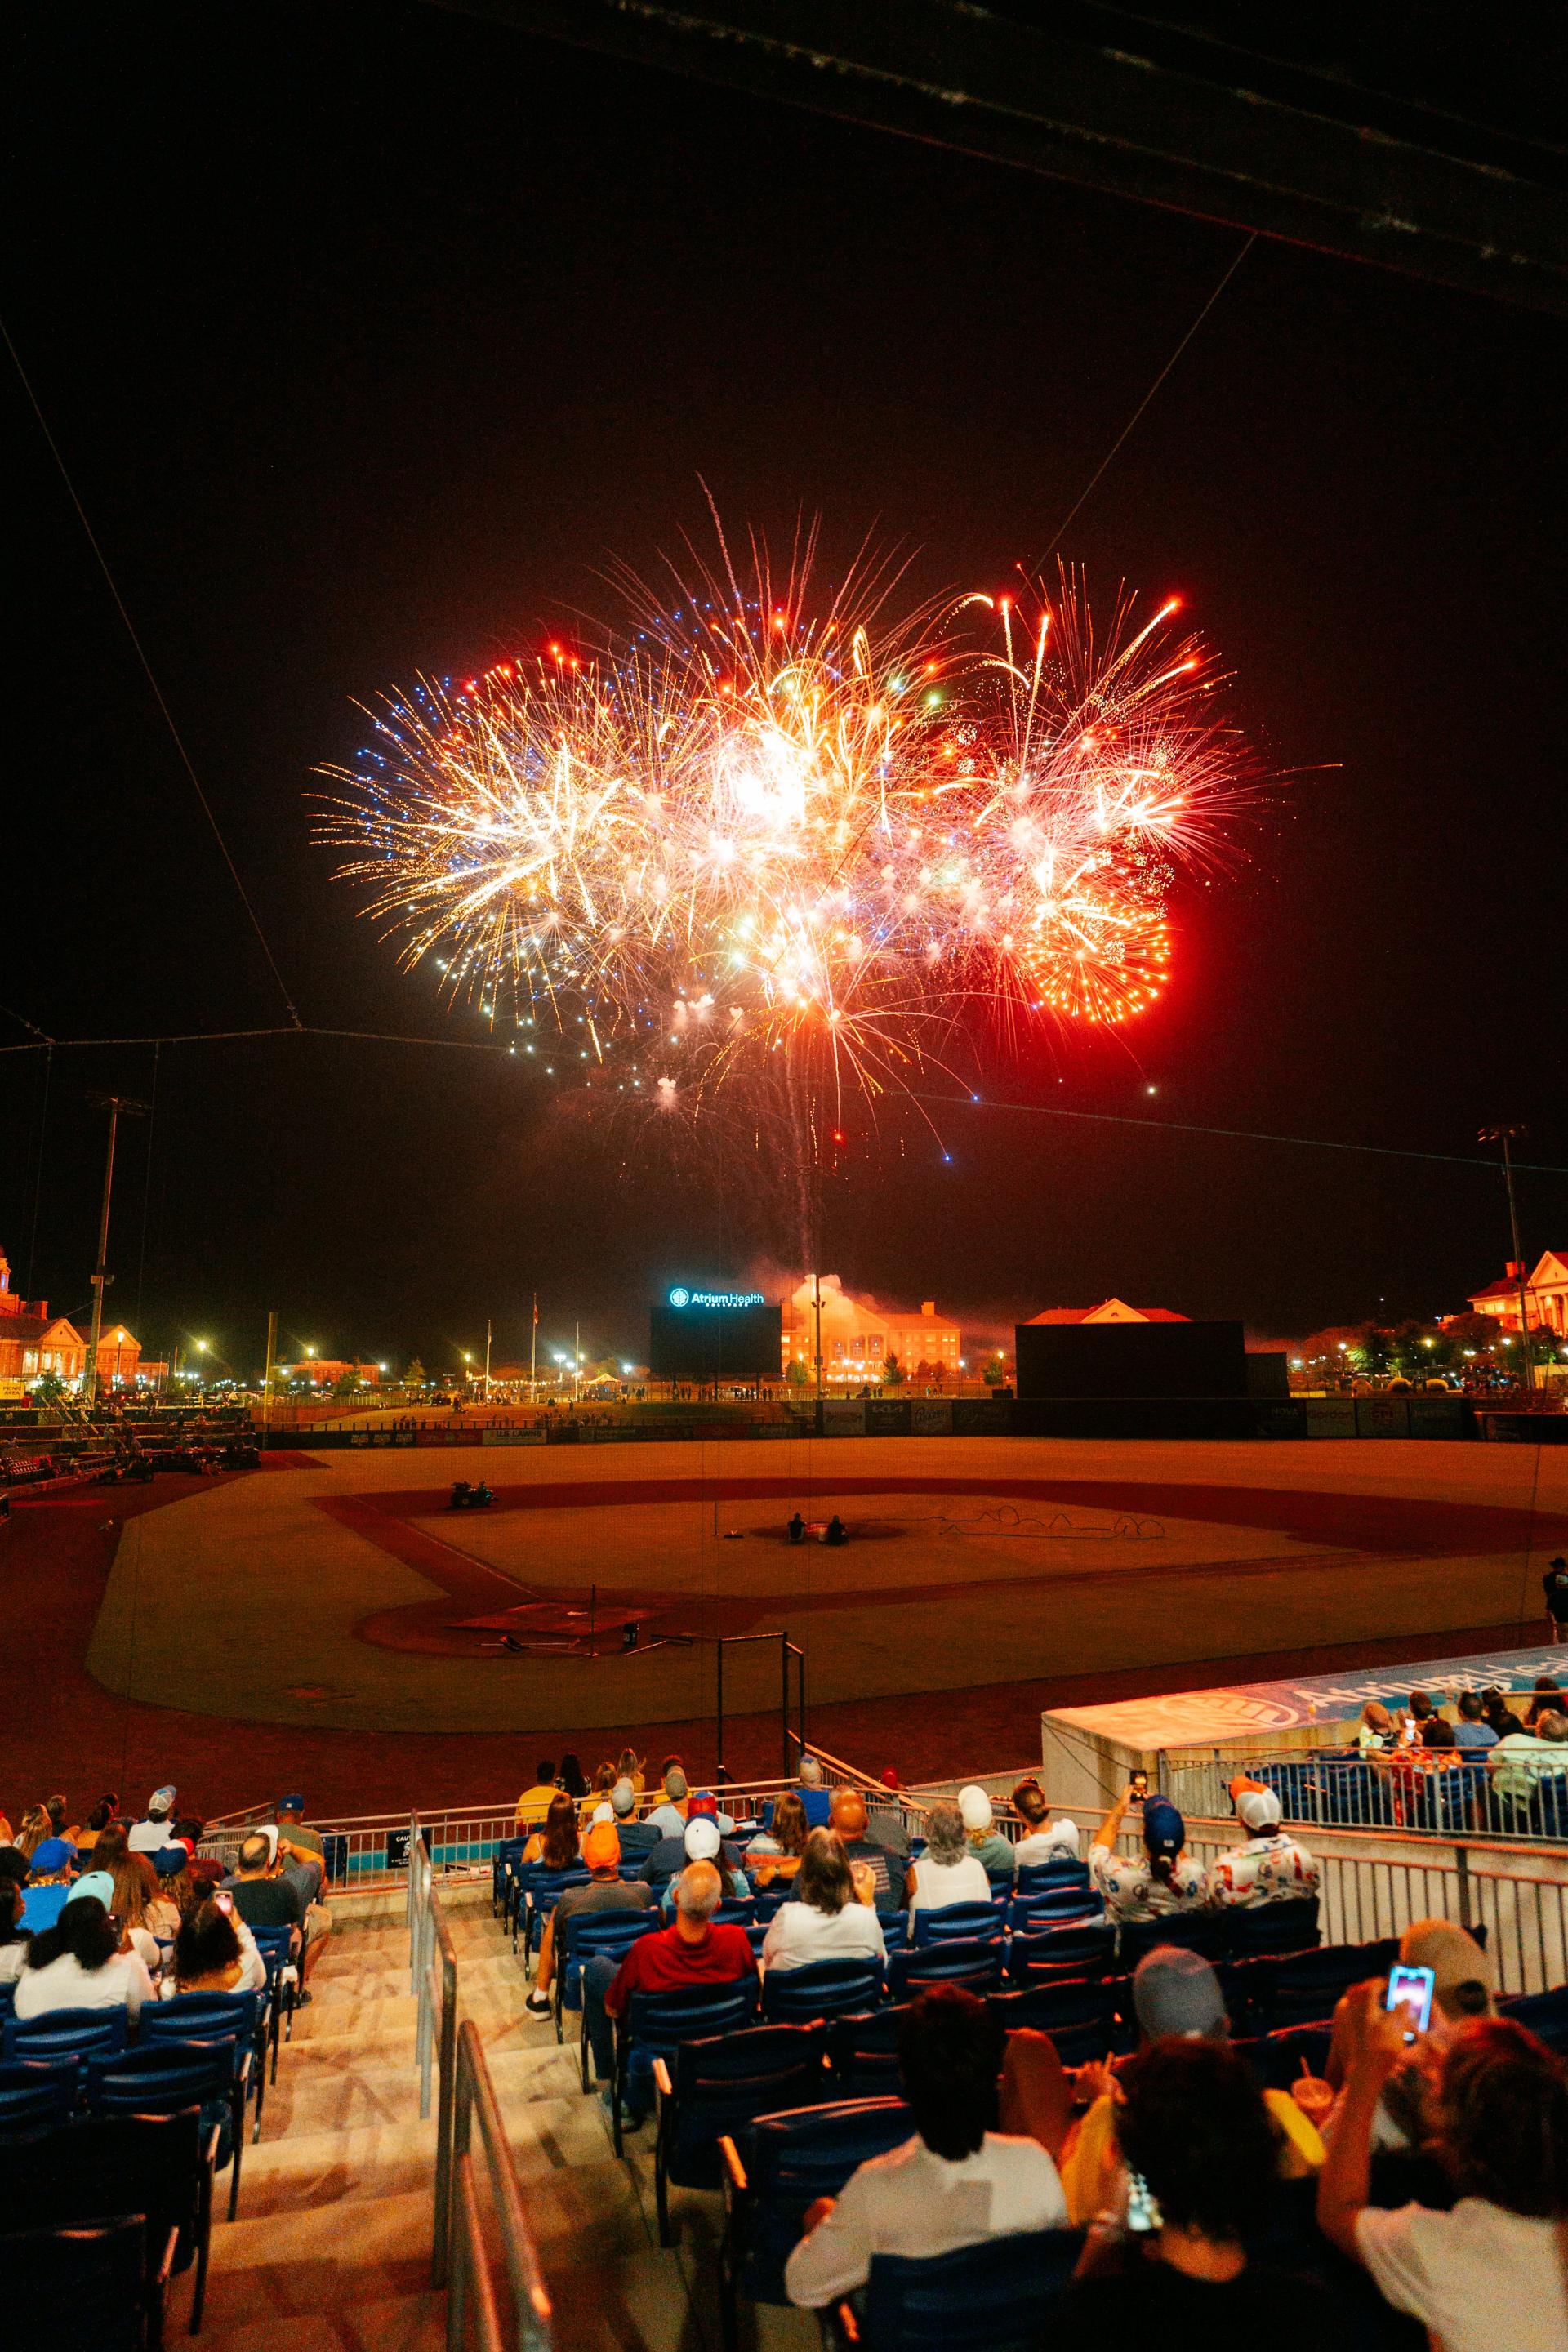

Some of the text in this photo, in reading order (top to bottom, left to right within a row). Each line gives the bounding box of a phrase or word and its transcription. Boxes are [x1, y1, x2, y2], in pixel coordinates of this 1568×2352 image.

[691, 1293, 764, 1303] Atrium Health
[1294, 1673, 1493, 1708] Atrium
